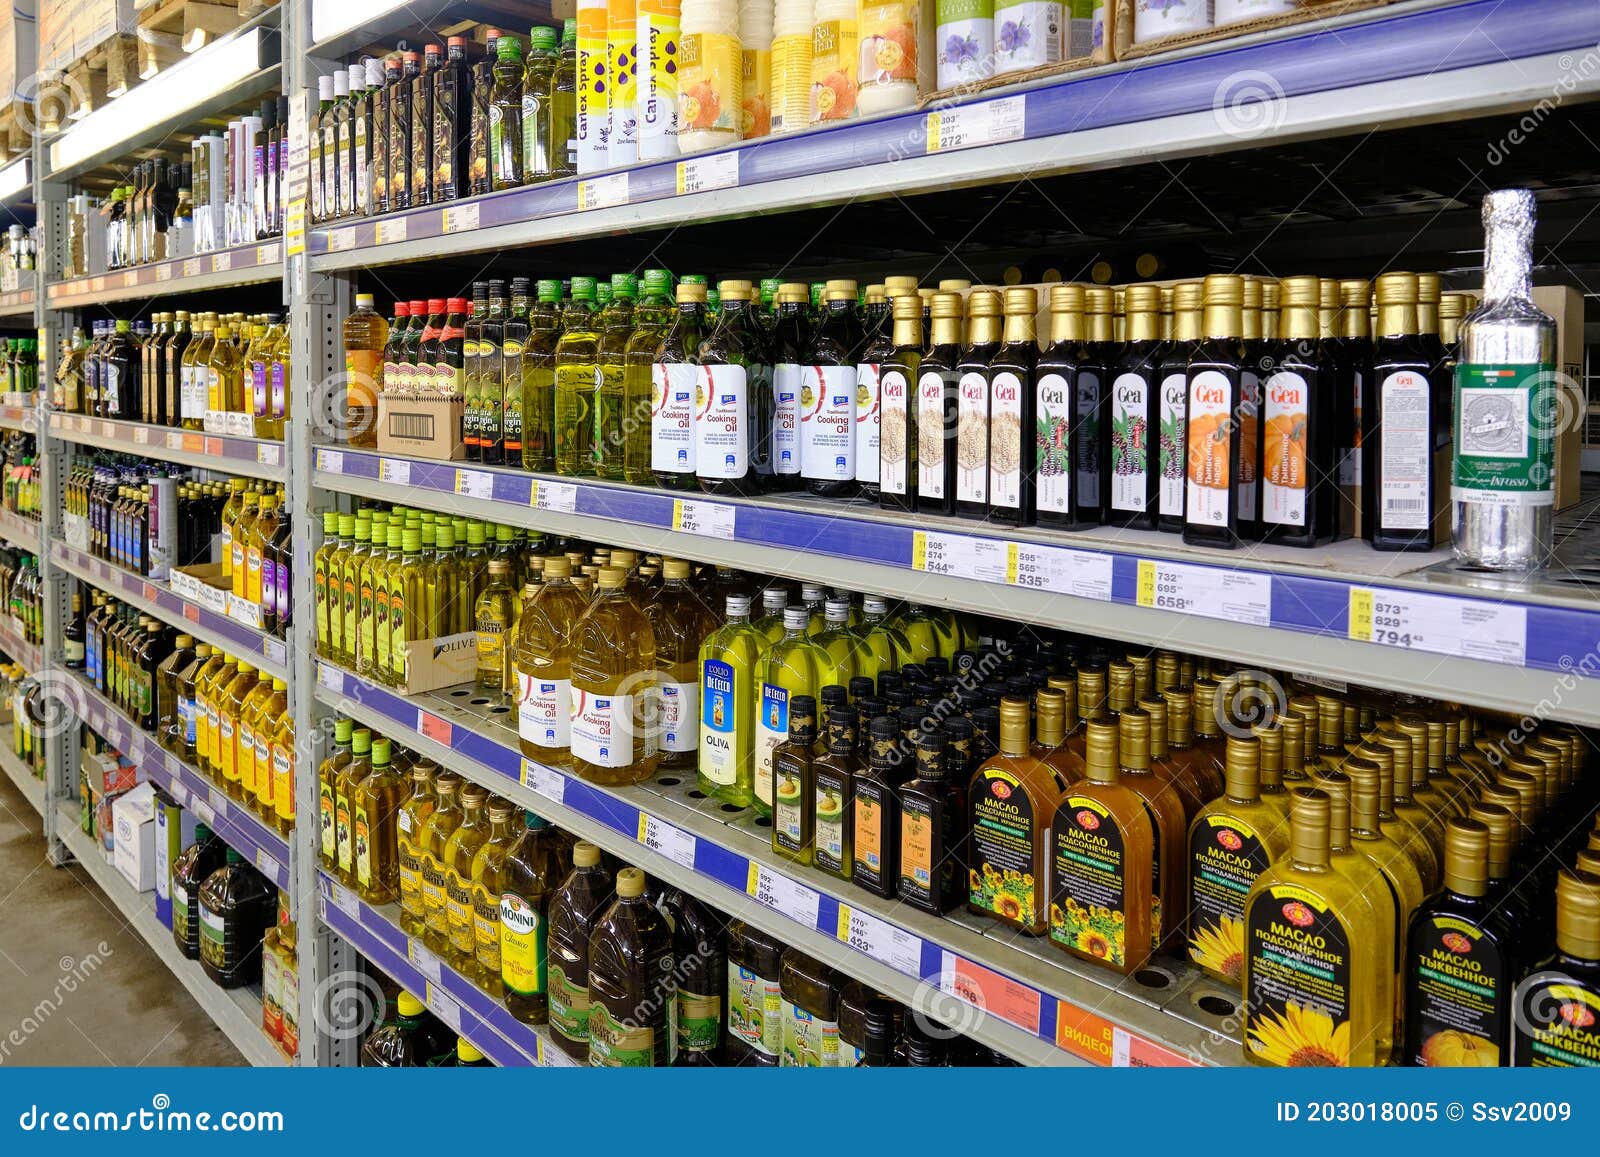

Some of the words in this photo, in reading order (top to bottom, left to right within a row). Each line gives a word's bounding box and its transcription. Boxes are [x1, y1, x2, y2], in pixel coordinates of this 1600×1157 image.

[579, 50, 590, 91] Spray
[579, 91, 588, 140] Carlex
[941, 135, 962, 147] 272
[885, 382, 903, 397] Gea
[922, 383, 940, 399] Gea
[962, 383, 983, 400] Gea
[995, 384, 1016, 401] Gea
[1041, 386, 1063, 404] Gea
[1118, 386, 1141, 404] Gea
[1196, 385, 1224, 404] Gea
[1271, 385, 1300, 405] Gea
[662, 411, 690, 420] Cooking
[707, 415, 737, 424] Cooking
[817, 416, 849, 425] Cooking
[678, 420, 690, 428] Oil
[725, 424, 737, 432] Oil
[682, 521, 697, 530] 472
[928, 541, 943, 549] 605
[928, 551, 942, 559] 574
[1019, 553, 1036, 562] 595
[928, 561, 949, 573] 544
[1018, 563, 1036, 572] 565
[1018, 574, 1043, 587] 535
[1157, 572, 1177, 582] 732
[1157, 583, 1177, 594] 695
[1157, 595, 1185, 609] 658
[1375, 603, 1401, 614] 873
[1375, 615, 1401, 627] 829
[1375, 629, 1412, 646] 794
[442, 639, 474, 652] OLIVE
[709, 665, 729, 676] L'OLIO
[529, 698, 556, 711] Cooking
[544, 710, 557, 718] Oil
[583, 714, 611, 728] Cooking
[666, 714, 678, 722] Oil
[599, 727, 611, 736] Oil
[706, 735, 730, 751] OLIVA
[984, 797, 1019, 815] МАСЛО
[975, 802, 1030, 825] ПОДСОЛНЕЧНОЕ
[646, 836, 659, 849] 696
[1068, 827, 1108, 847] МАСЛО
[1058, 833, 1121, 859] ПОДСОЛНЕЧНОЕ
[1208, 846, 1251, 869] МАСЛО
[758, 891, 774, 905] 892
[501, 905, 534, 927] MONINI
[852, 916, 864, 927] 470
[1271, 921, 1326, 949] МАСЛО
[850, 936, 868, 952] 423
[1256, 929, 1343, 965] ПОДСОЛНЕЧНОЕ
[1262, 941, 1335, 971] СЫРОДАВЛЕННОЕ
[1432, 948, 1481, 972] МАСЛО
[1419, 954, 1496, 988] ТЫКВЕННОЕ
[1294, 971, 1333, 988] SUNFLOWER
[1333, 983, 1344, 992] OIL
